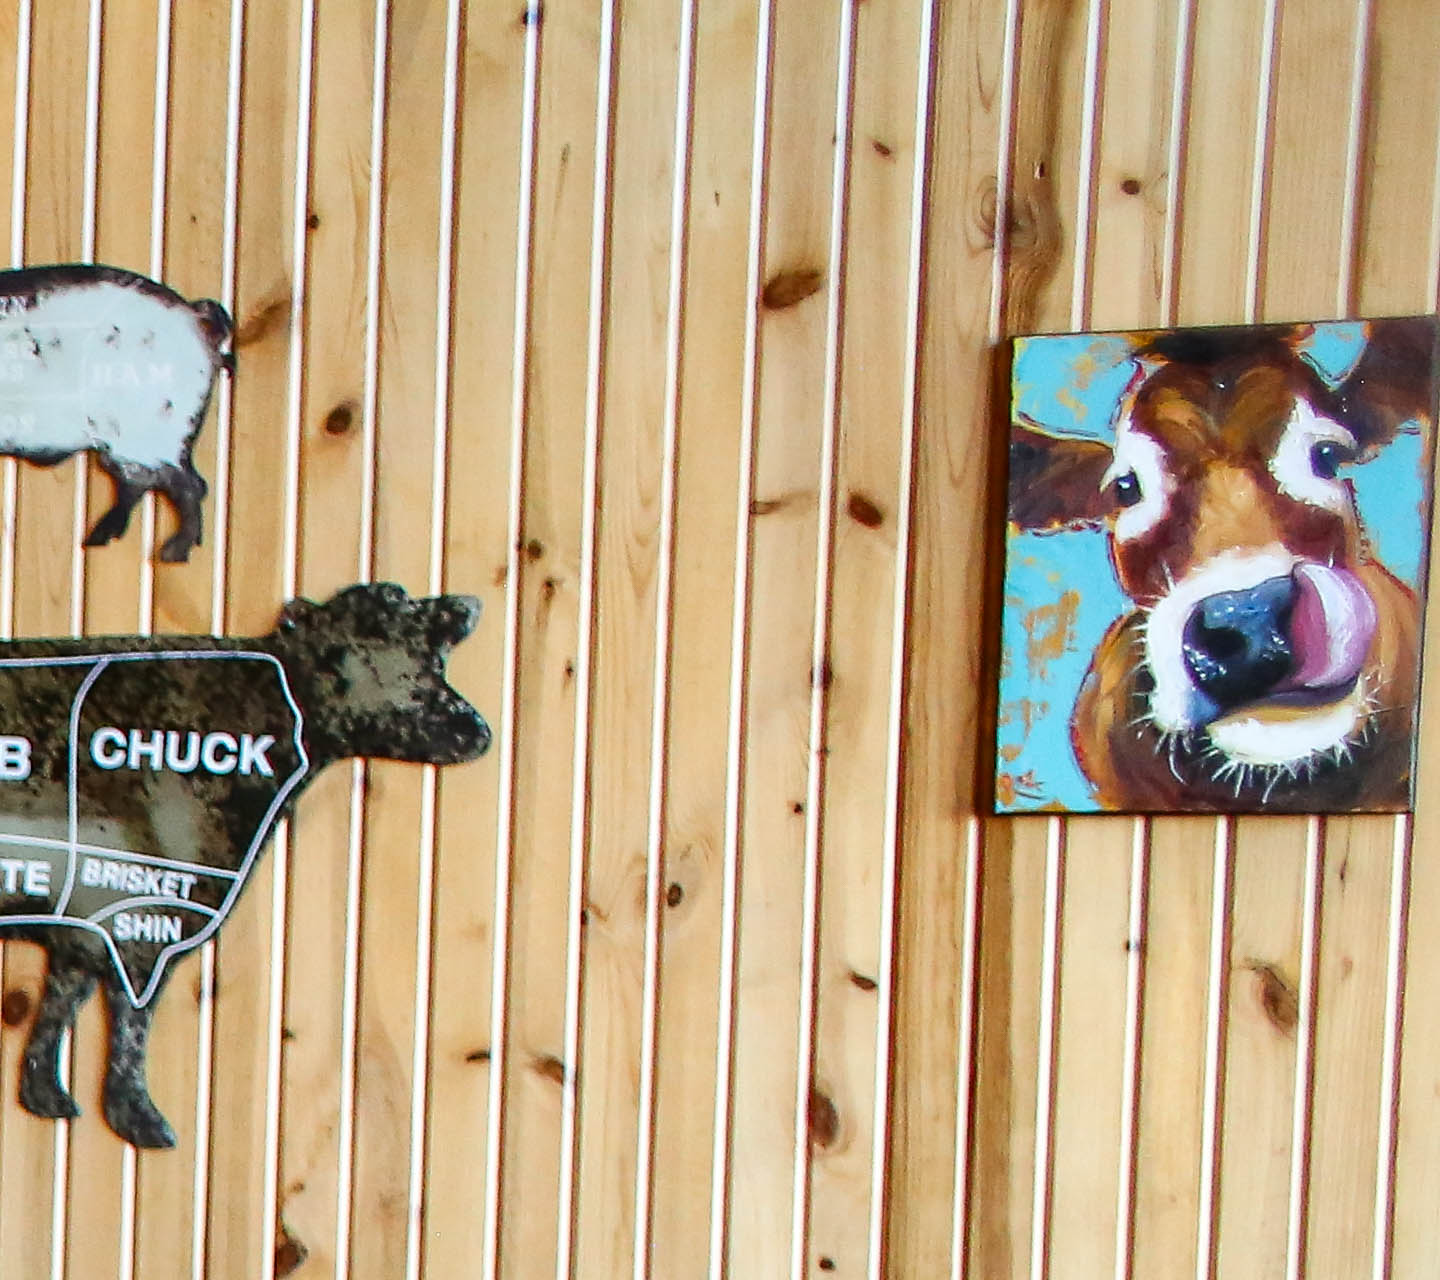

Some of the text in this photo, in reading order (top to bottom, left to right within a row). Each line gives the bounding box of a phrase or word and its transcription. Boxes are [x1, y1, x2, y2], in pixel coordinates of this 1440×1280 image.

[91, 363, 174, 386] HAM
[89, 727, 276, 777] CHUCK
[80, 859, 197, 900] BRISKET
[113, 912, 182, 944] SHIN
